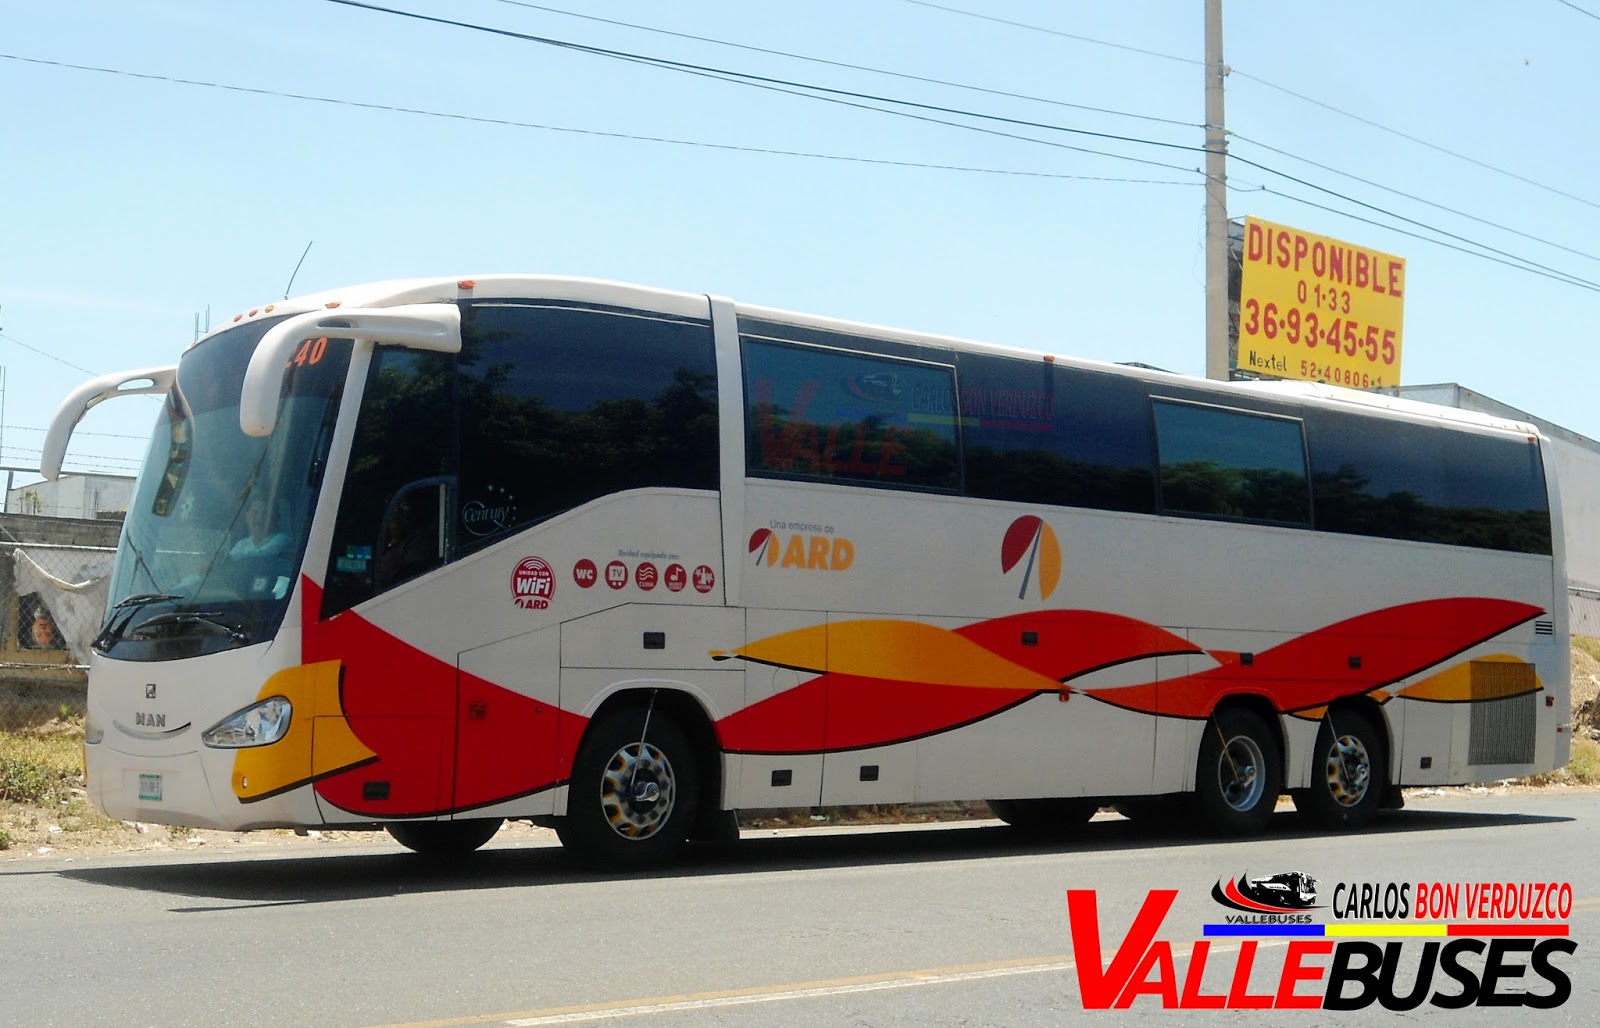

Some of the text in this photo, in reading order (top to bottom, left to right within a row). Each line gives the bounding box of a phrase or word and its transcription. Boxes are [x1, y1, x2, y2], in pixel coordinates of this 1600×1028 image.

[1248, 223, 1403, 298] DISPONIBLE
[1249, 350, 1287, 372] Nextel
[770, 520, 834, 533] Una empresa de
[781, 534, 855, 571] ARD
[576, 568, 593, 579] WC
[612, 569, 622, 577] TV
[517, 577, 551, 595] WiFi
[525, 600, 548, 610] ARD
[135, 712, 166, 728] MAN
